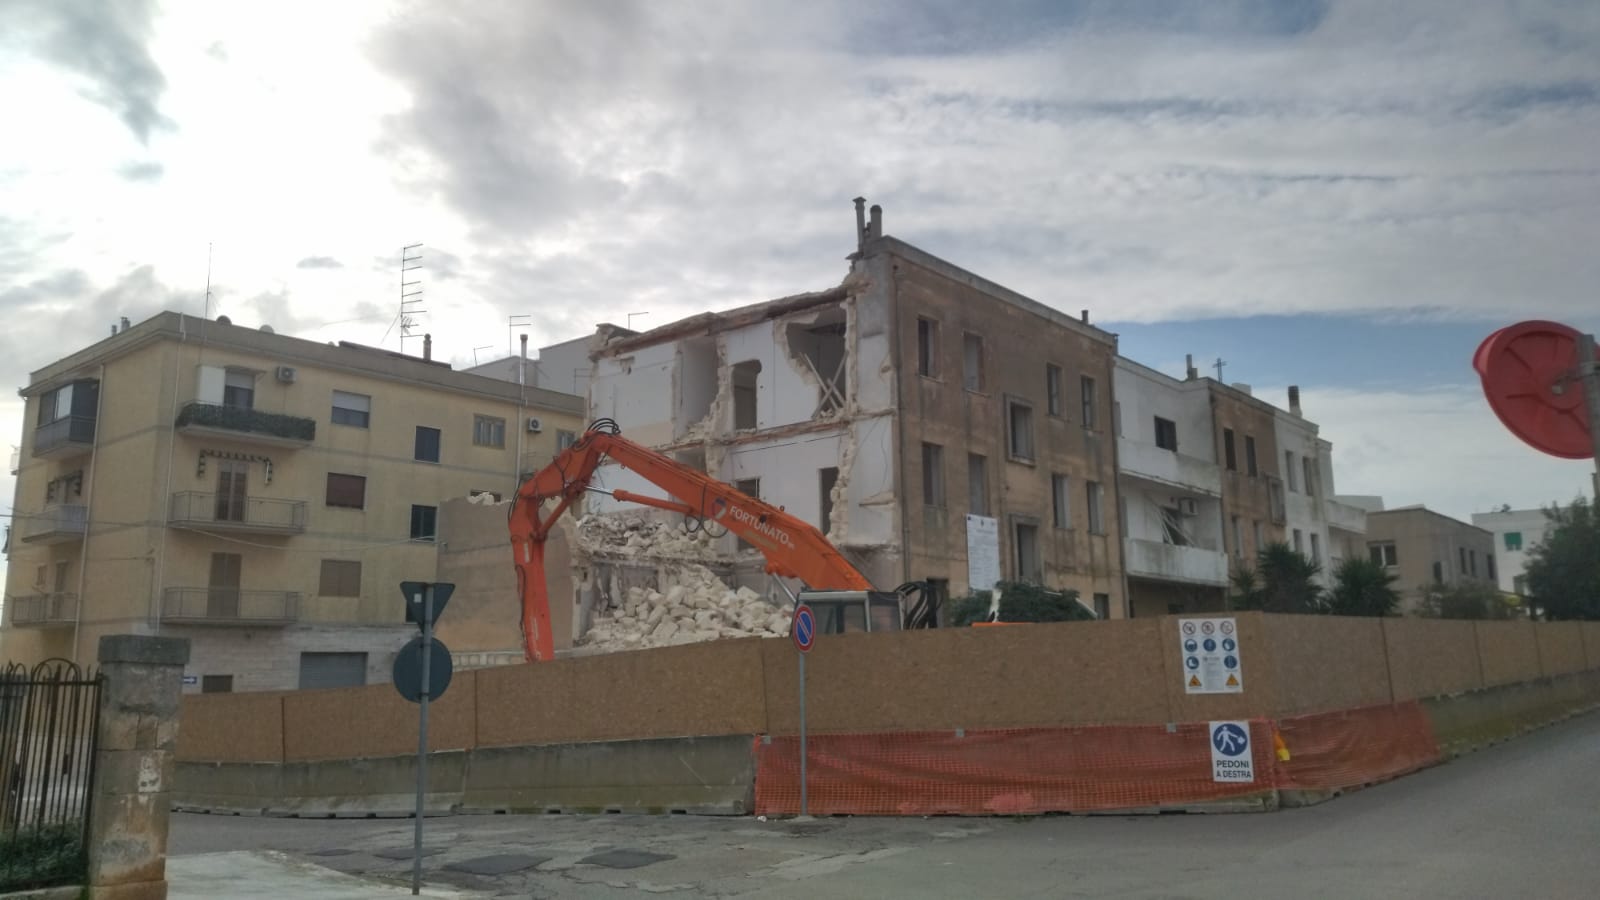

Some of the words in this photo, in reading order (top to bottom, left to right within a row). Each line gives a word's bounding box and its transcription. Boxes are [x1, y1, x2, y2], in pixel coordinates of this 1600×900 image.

[729, 505, 789, 545] FORTUNATO
[1216, 760, 1250, 768] PEDONI
[1223, 770, 1252, 778] DESTRA
